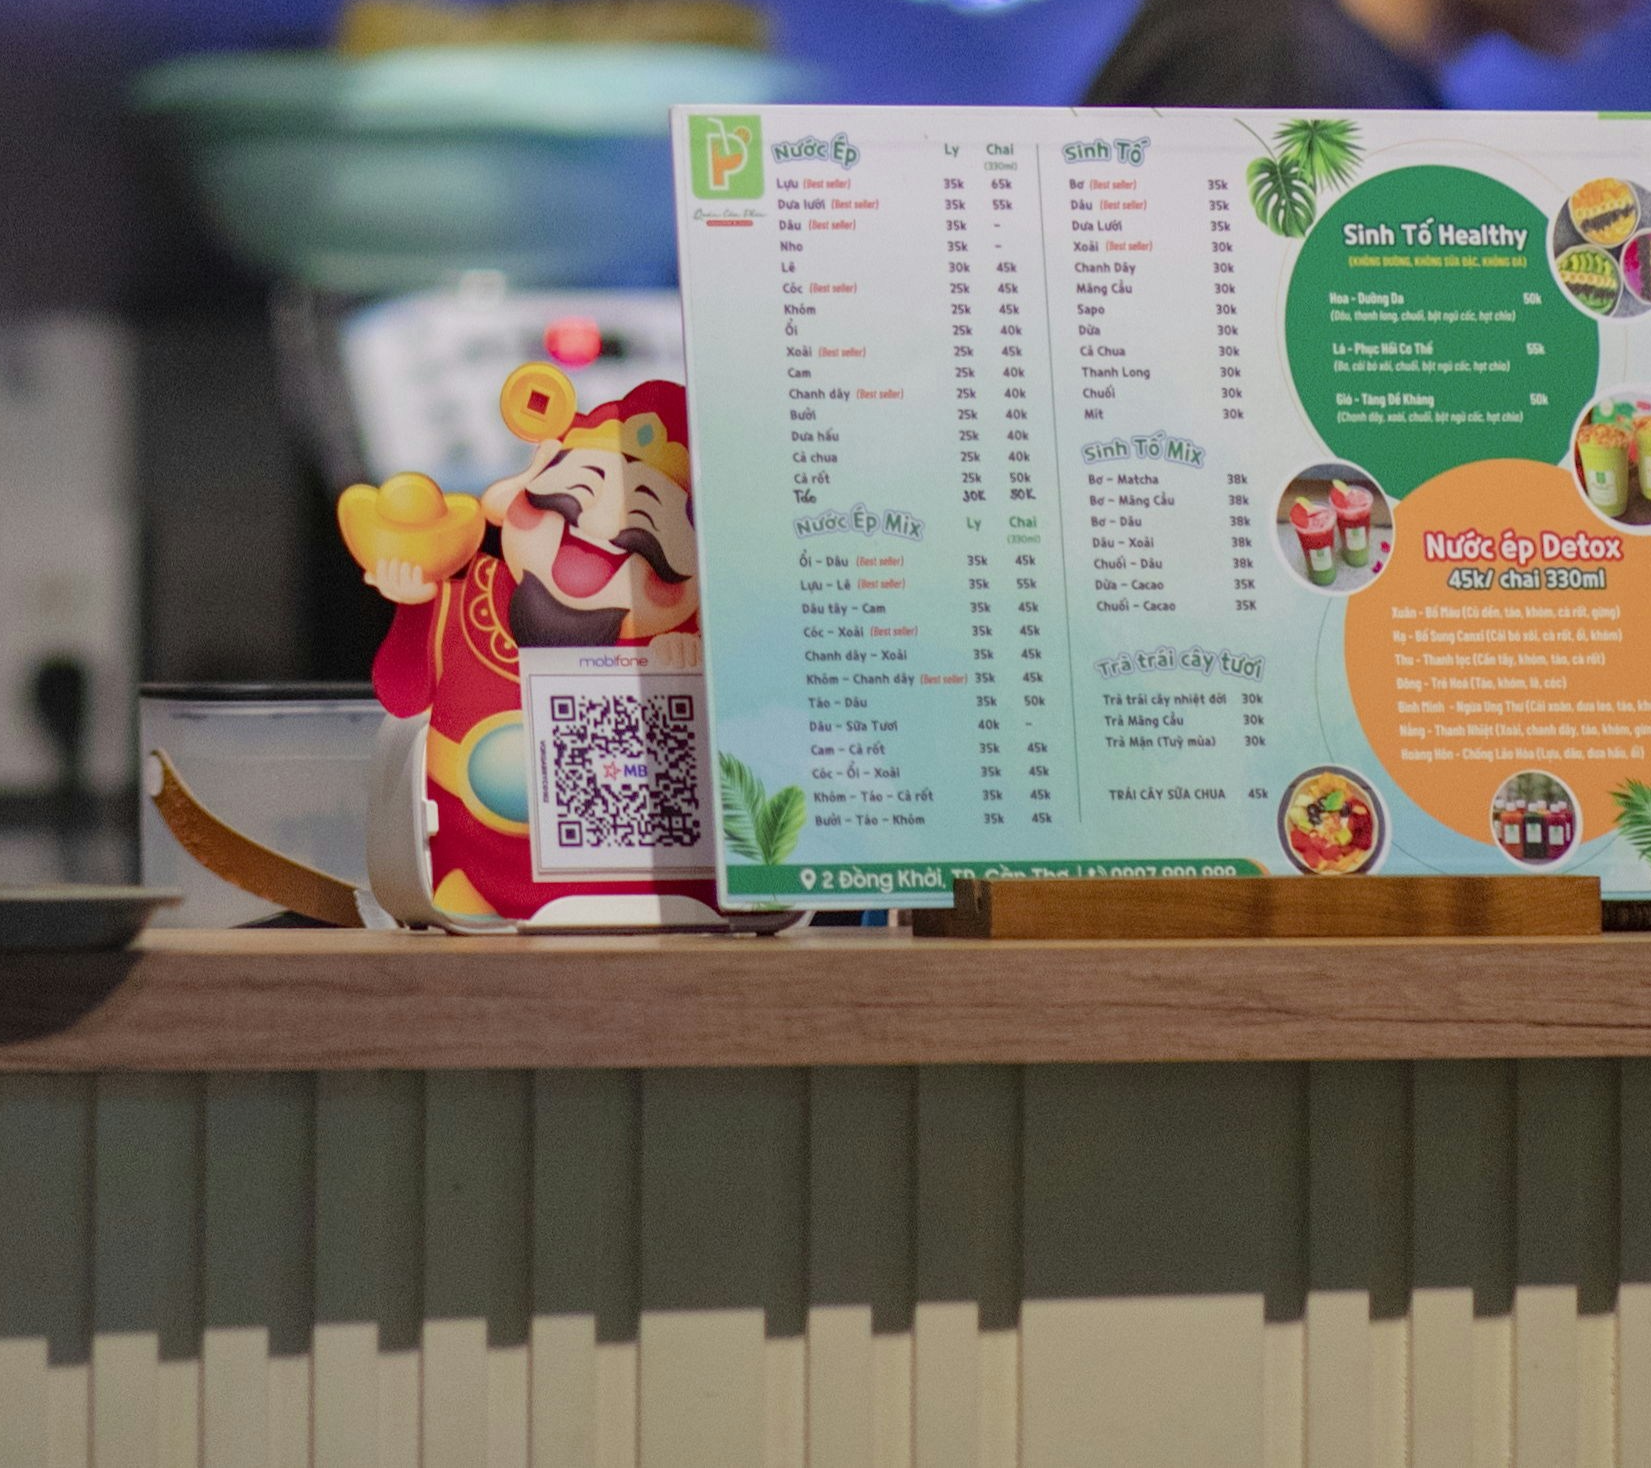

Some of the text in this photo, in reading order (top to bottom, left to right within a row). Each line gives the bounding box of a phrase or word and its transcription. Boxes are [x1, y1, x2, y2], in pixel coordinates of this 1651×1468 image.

[774, 133, 1014, 167] Nước Ép Ly Chai
[1065, 137, 1149, 165] Sinh Tố
[776, 178, 1012, 191] Lựu 35k 65k
[1344, 218, 1527, 251] Sinh Tố Healthy
[781, 261, 1016, 273] Lê 30k 45k
[1077, 304, 1236, 317] Sapo 30k
[1081, 366, 1241, 380] Thanh Long 30k
[1084, 432, 1204, 466] Sinh Tố Mix
[795, 506, 924, 538] Nước Ép Mix
[1426, 531, 1622, 565] Nước ép Detox
[1448, 569, 1606, 589] 45k/ chai 330ml
[578, 654, 649, 668] mobifone
[623, 764, 648, 778] MB
[1109, 786, 1268, 800] TRÁI CÂY SỮA CHUA 45k
[822, 870, 834, 889] 2
[839, 867, 893, 891] Đồng
